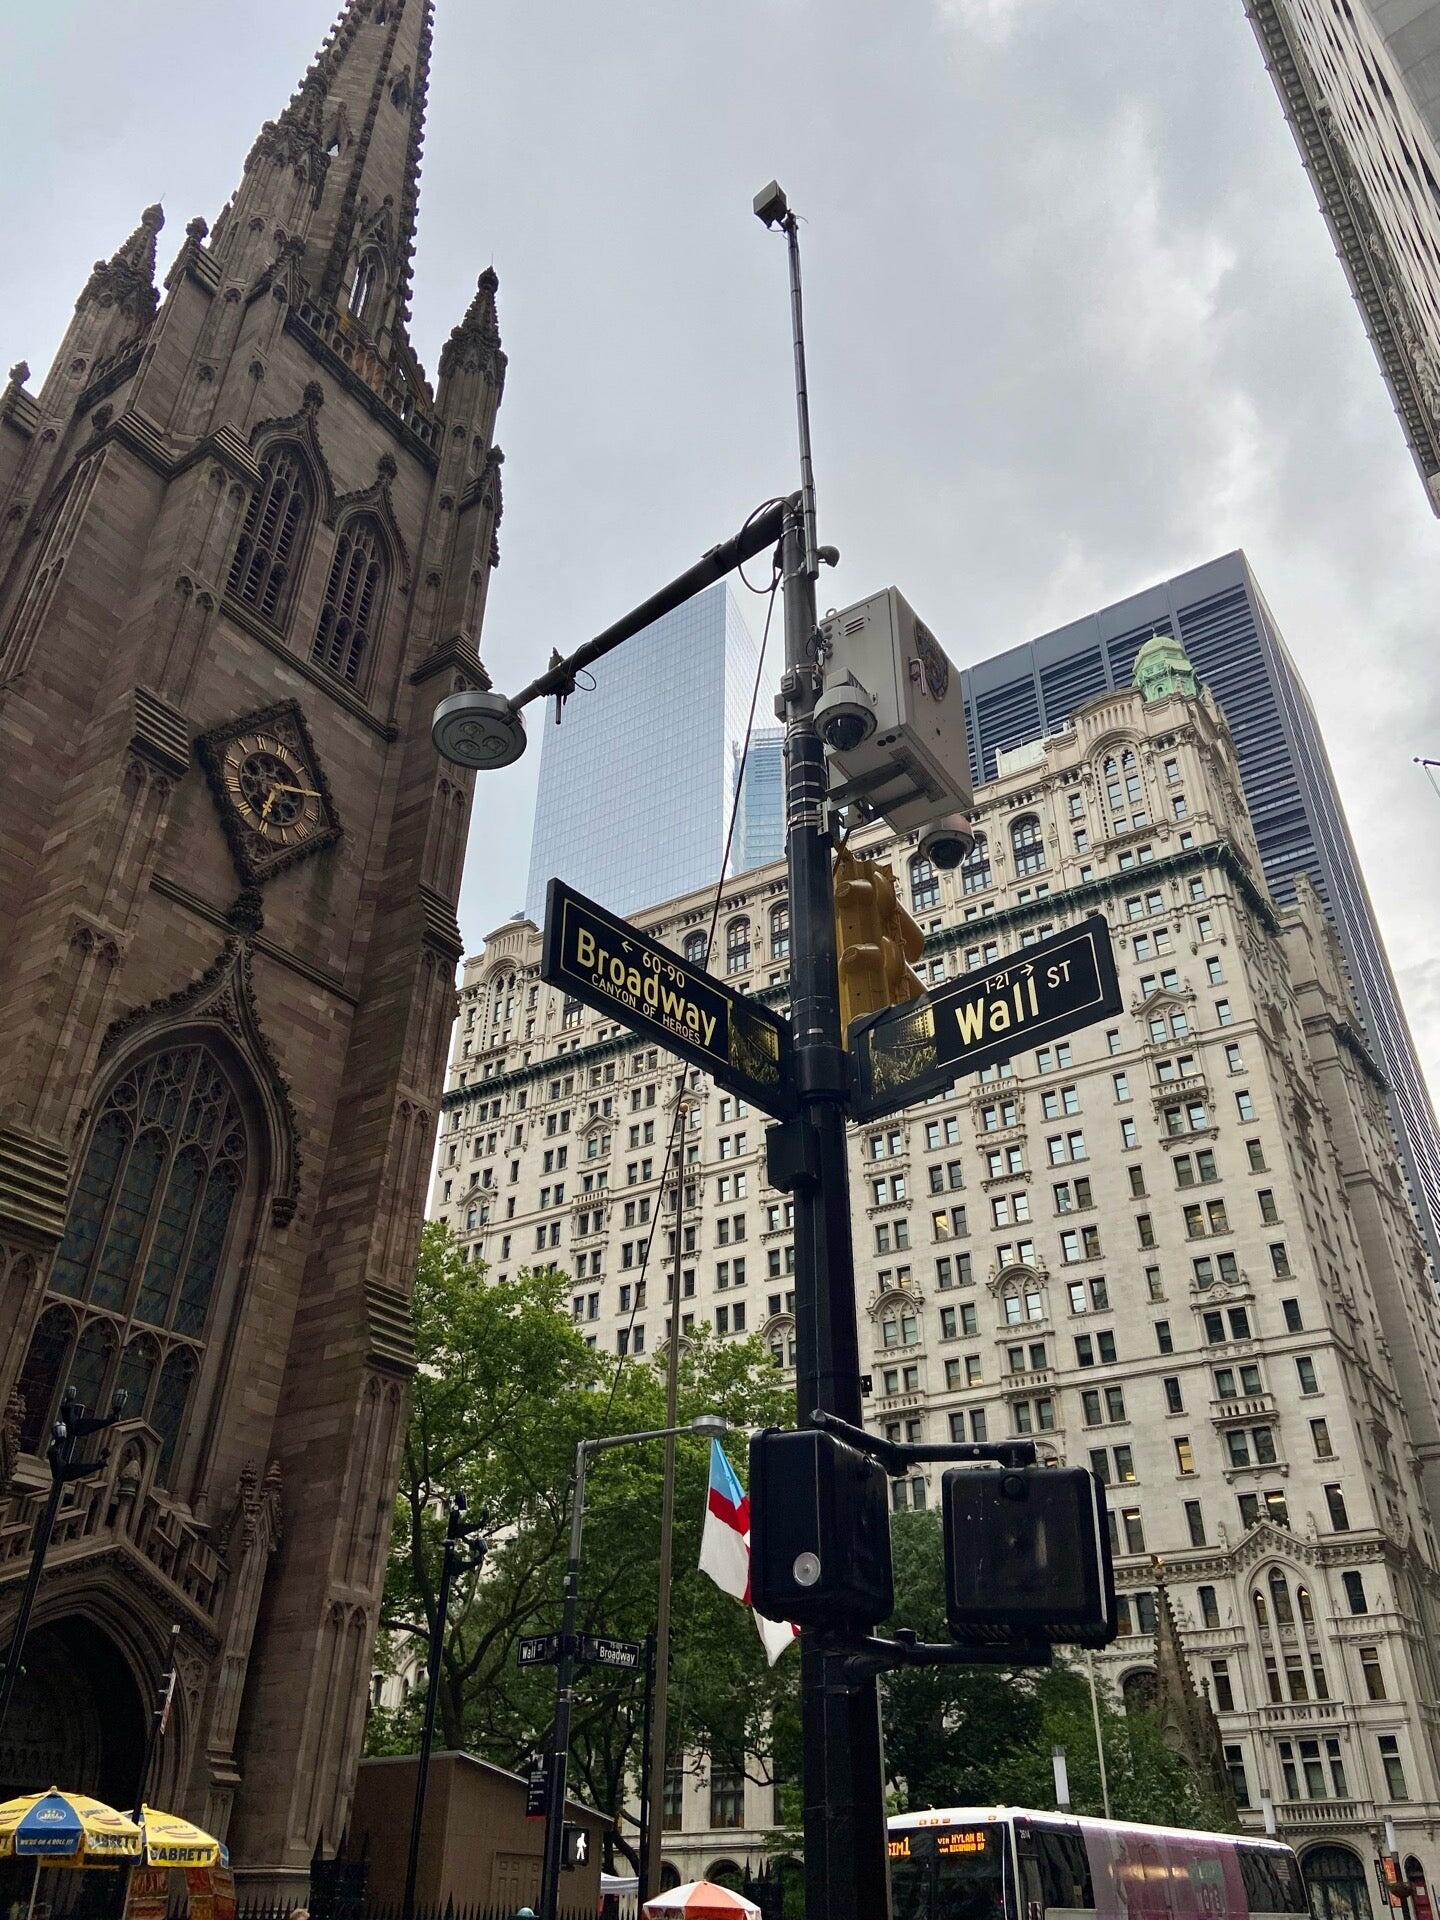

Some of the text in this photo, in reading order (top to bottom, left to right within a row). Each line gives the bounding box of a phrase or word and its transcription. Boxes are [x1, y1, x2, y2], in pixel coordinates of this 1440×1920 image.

[642, 951, 685, 989] 60-90
[985, 972, 1010, 994] 1-21
[576, 927, 717, 1046] Broadway
[591, 973, 701, 1045] CANYON OF HEROES
[954, 959, 1072, 1046] Wall ST
[522, 1643, 536, 1660] Wall
[600, 1646, 635, 1665] Broadway
[951, 1833, 975, 1844] HYLAN
[976, 1832, 986, 1842] BL
